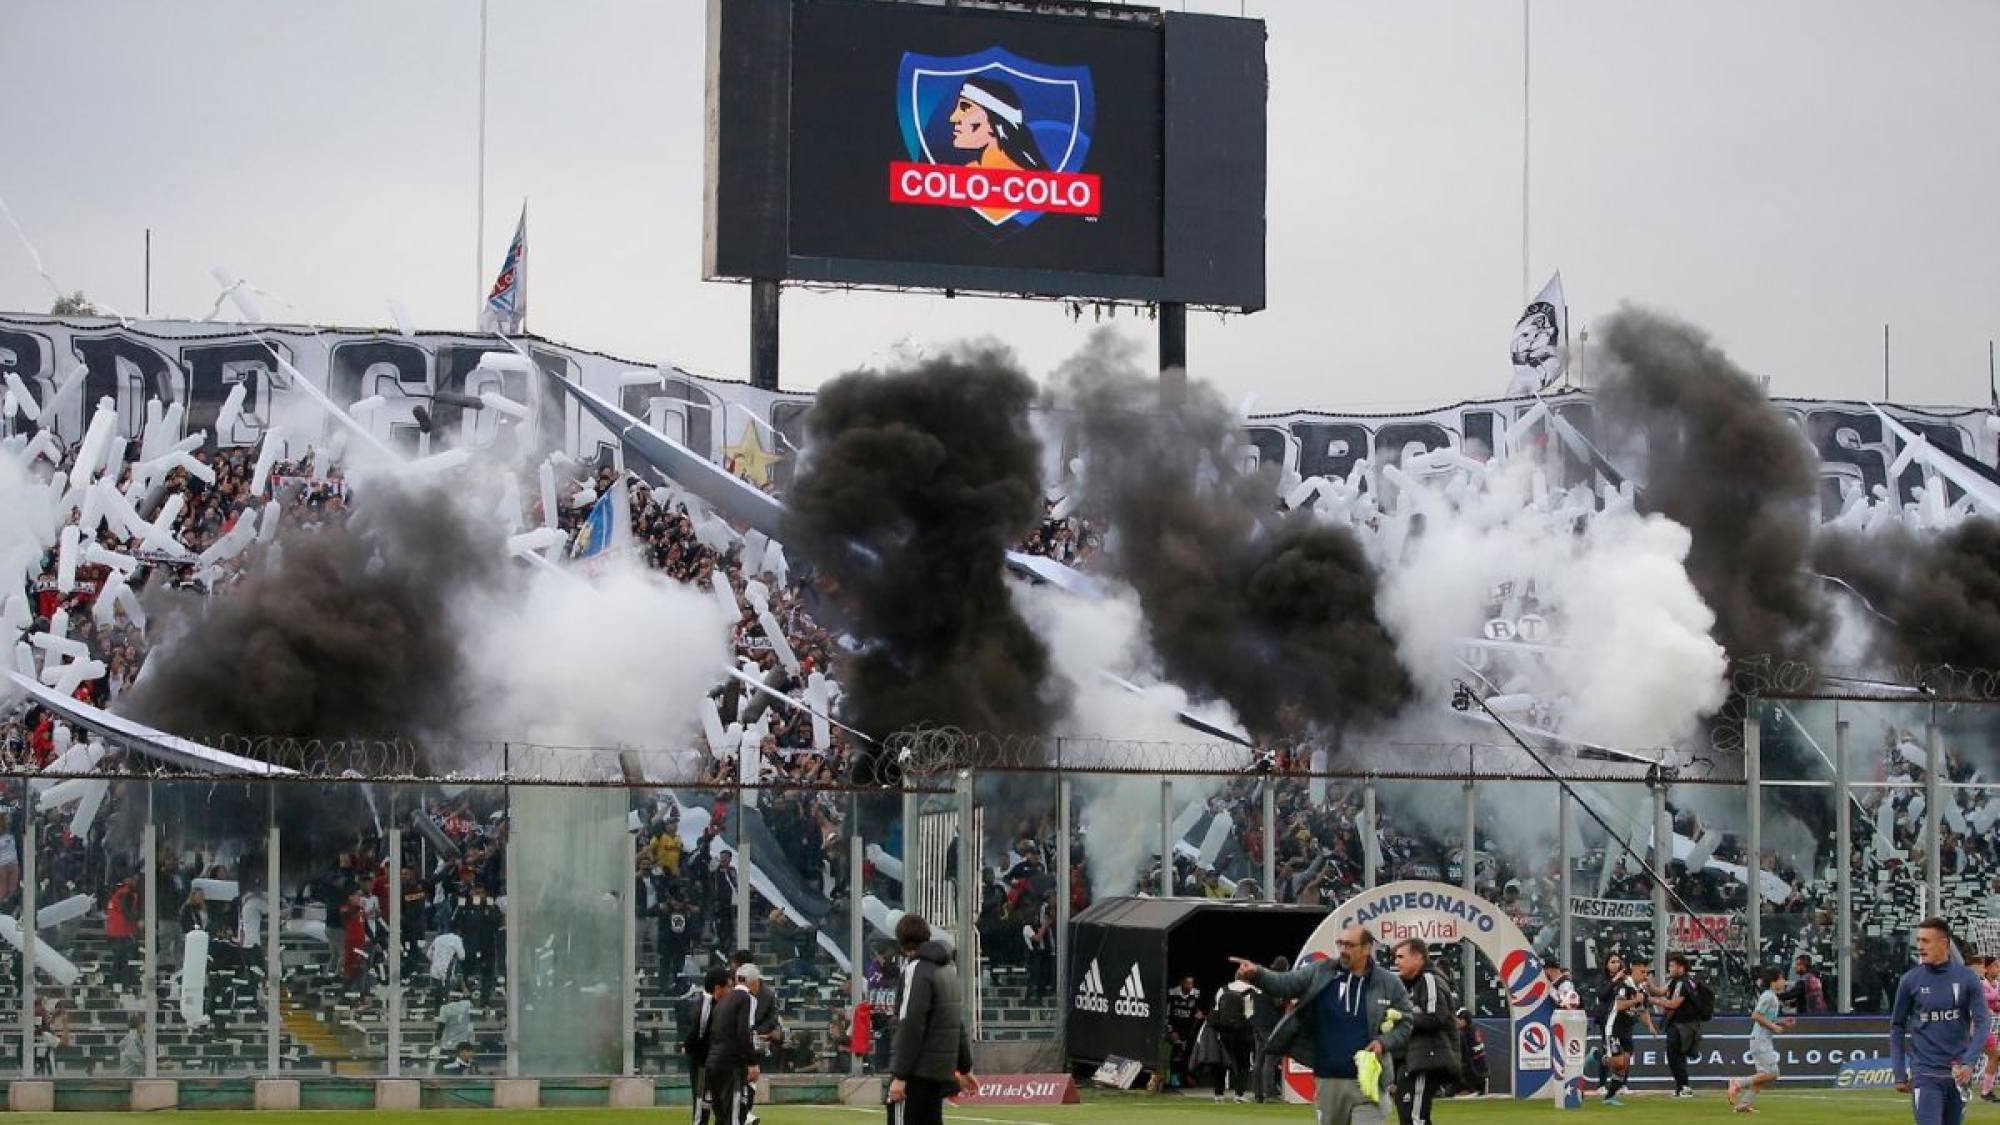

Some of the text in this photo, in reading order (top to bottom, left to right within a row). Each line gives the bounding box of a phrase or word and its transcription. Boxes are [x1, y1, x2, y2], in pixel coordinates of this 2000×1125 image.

[901, 169, 1090, 207] COLO-COLO
[1342, 891, 1493, 932] CAMPEONATO
[1381, 920, 1457, 939] PlanVital
[1075, 993, 1108, 1013] adidas
[1114, 996, 1150, 1018] adidas
[1931, 1009, 1960, 1022] BICE
[1022, 1081, 1059, 1099] Sur
